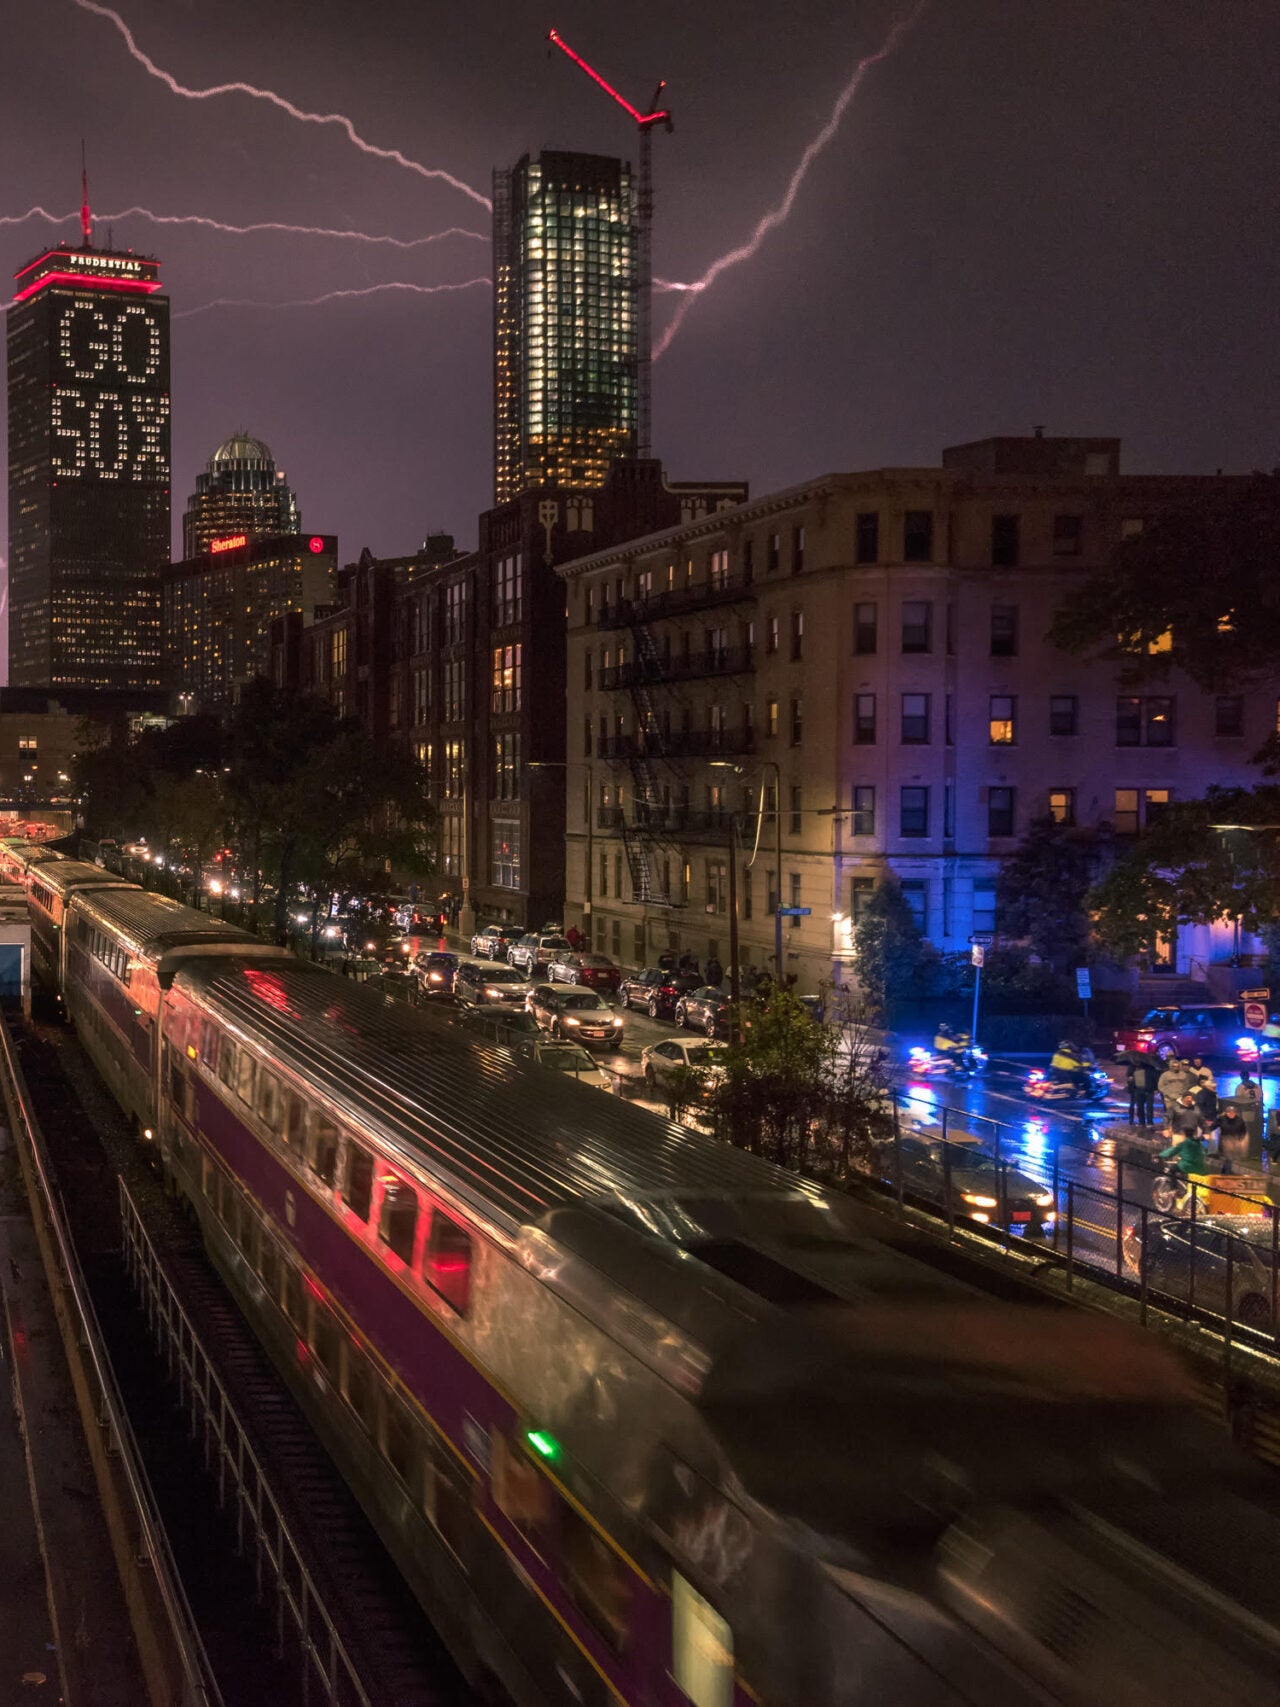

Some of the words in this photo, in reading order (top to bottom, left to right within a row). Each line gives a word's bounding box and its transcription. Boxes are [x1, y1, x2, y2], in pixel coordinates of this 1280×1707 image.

[70, 256, 141, 271] PRUDENTIAL
[60, 301, 160, 383] GO
[52, 389, 169, 482] SOX
[211, 535, 246, 553] Sheraton
